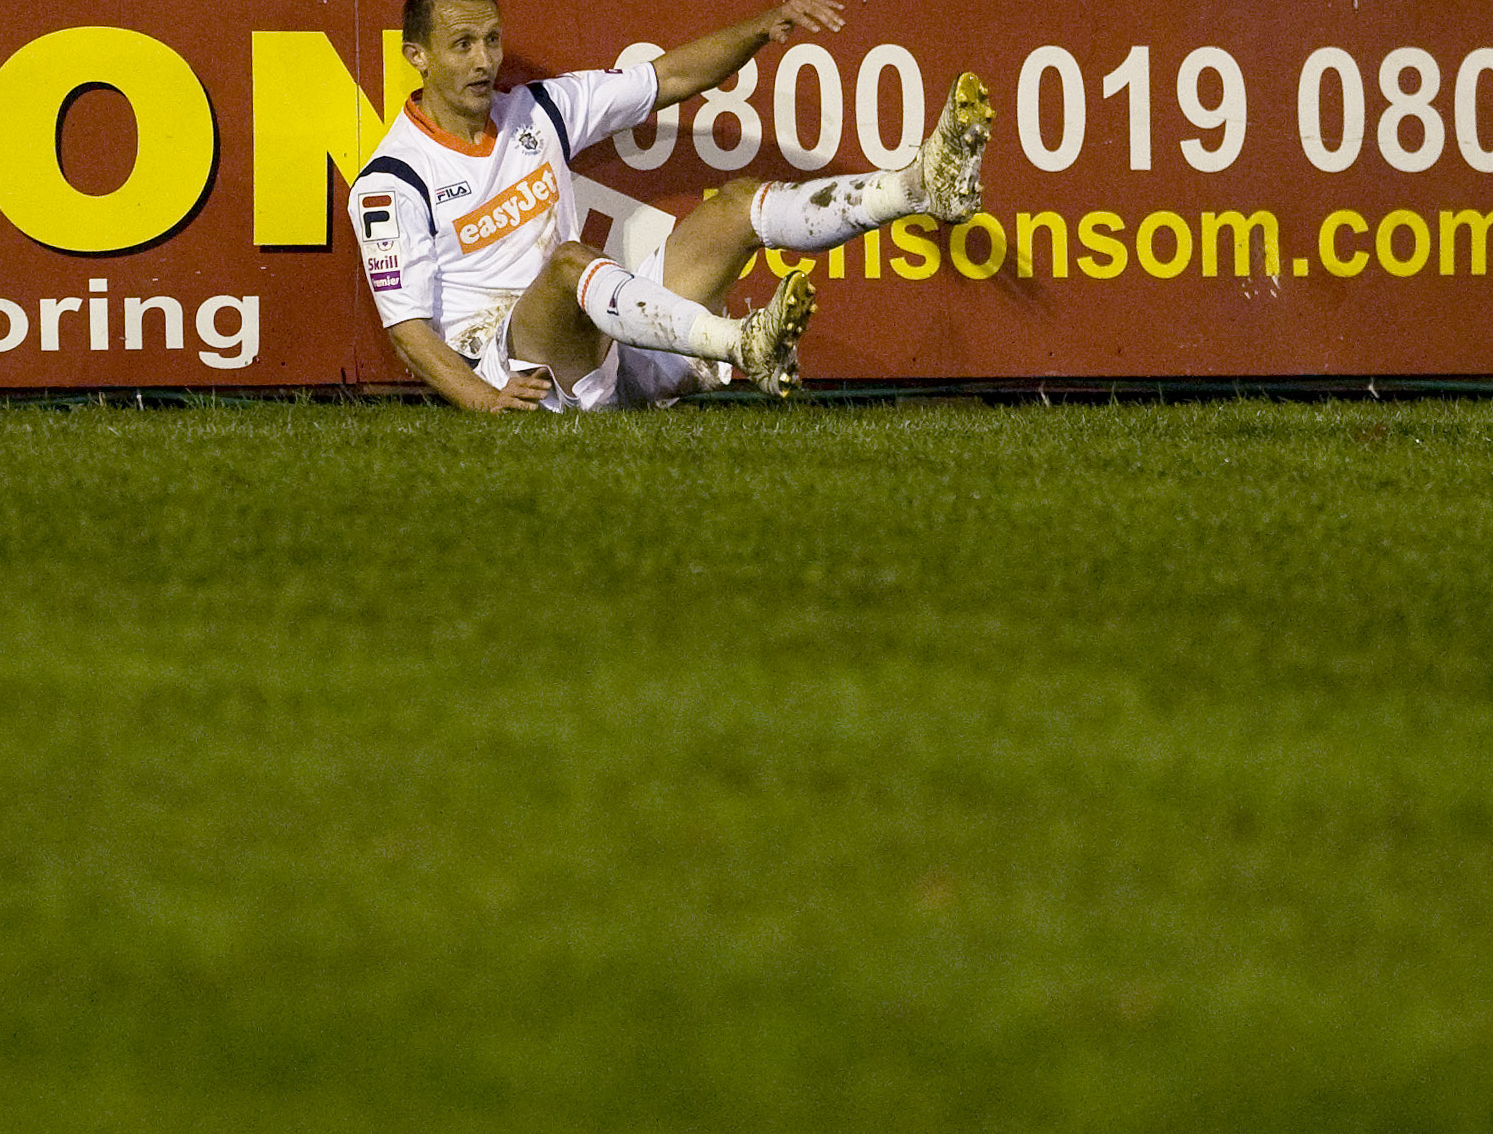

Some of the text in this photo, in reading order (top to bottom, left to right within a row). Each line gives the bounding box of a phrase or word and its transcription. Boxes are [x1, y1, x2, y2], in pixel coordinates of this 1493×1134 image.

[1016, 44, 1247, 172] 019
[435, 185, 468, 202] FILA
[459, 168, 557, 245] easyJet
[367, 254, 399, 271] Skrill
